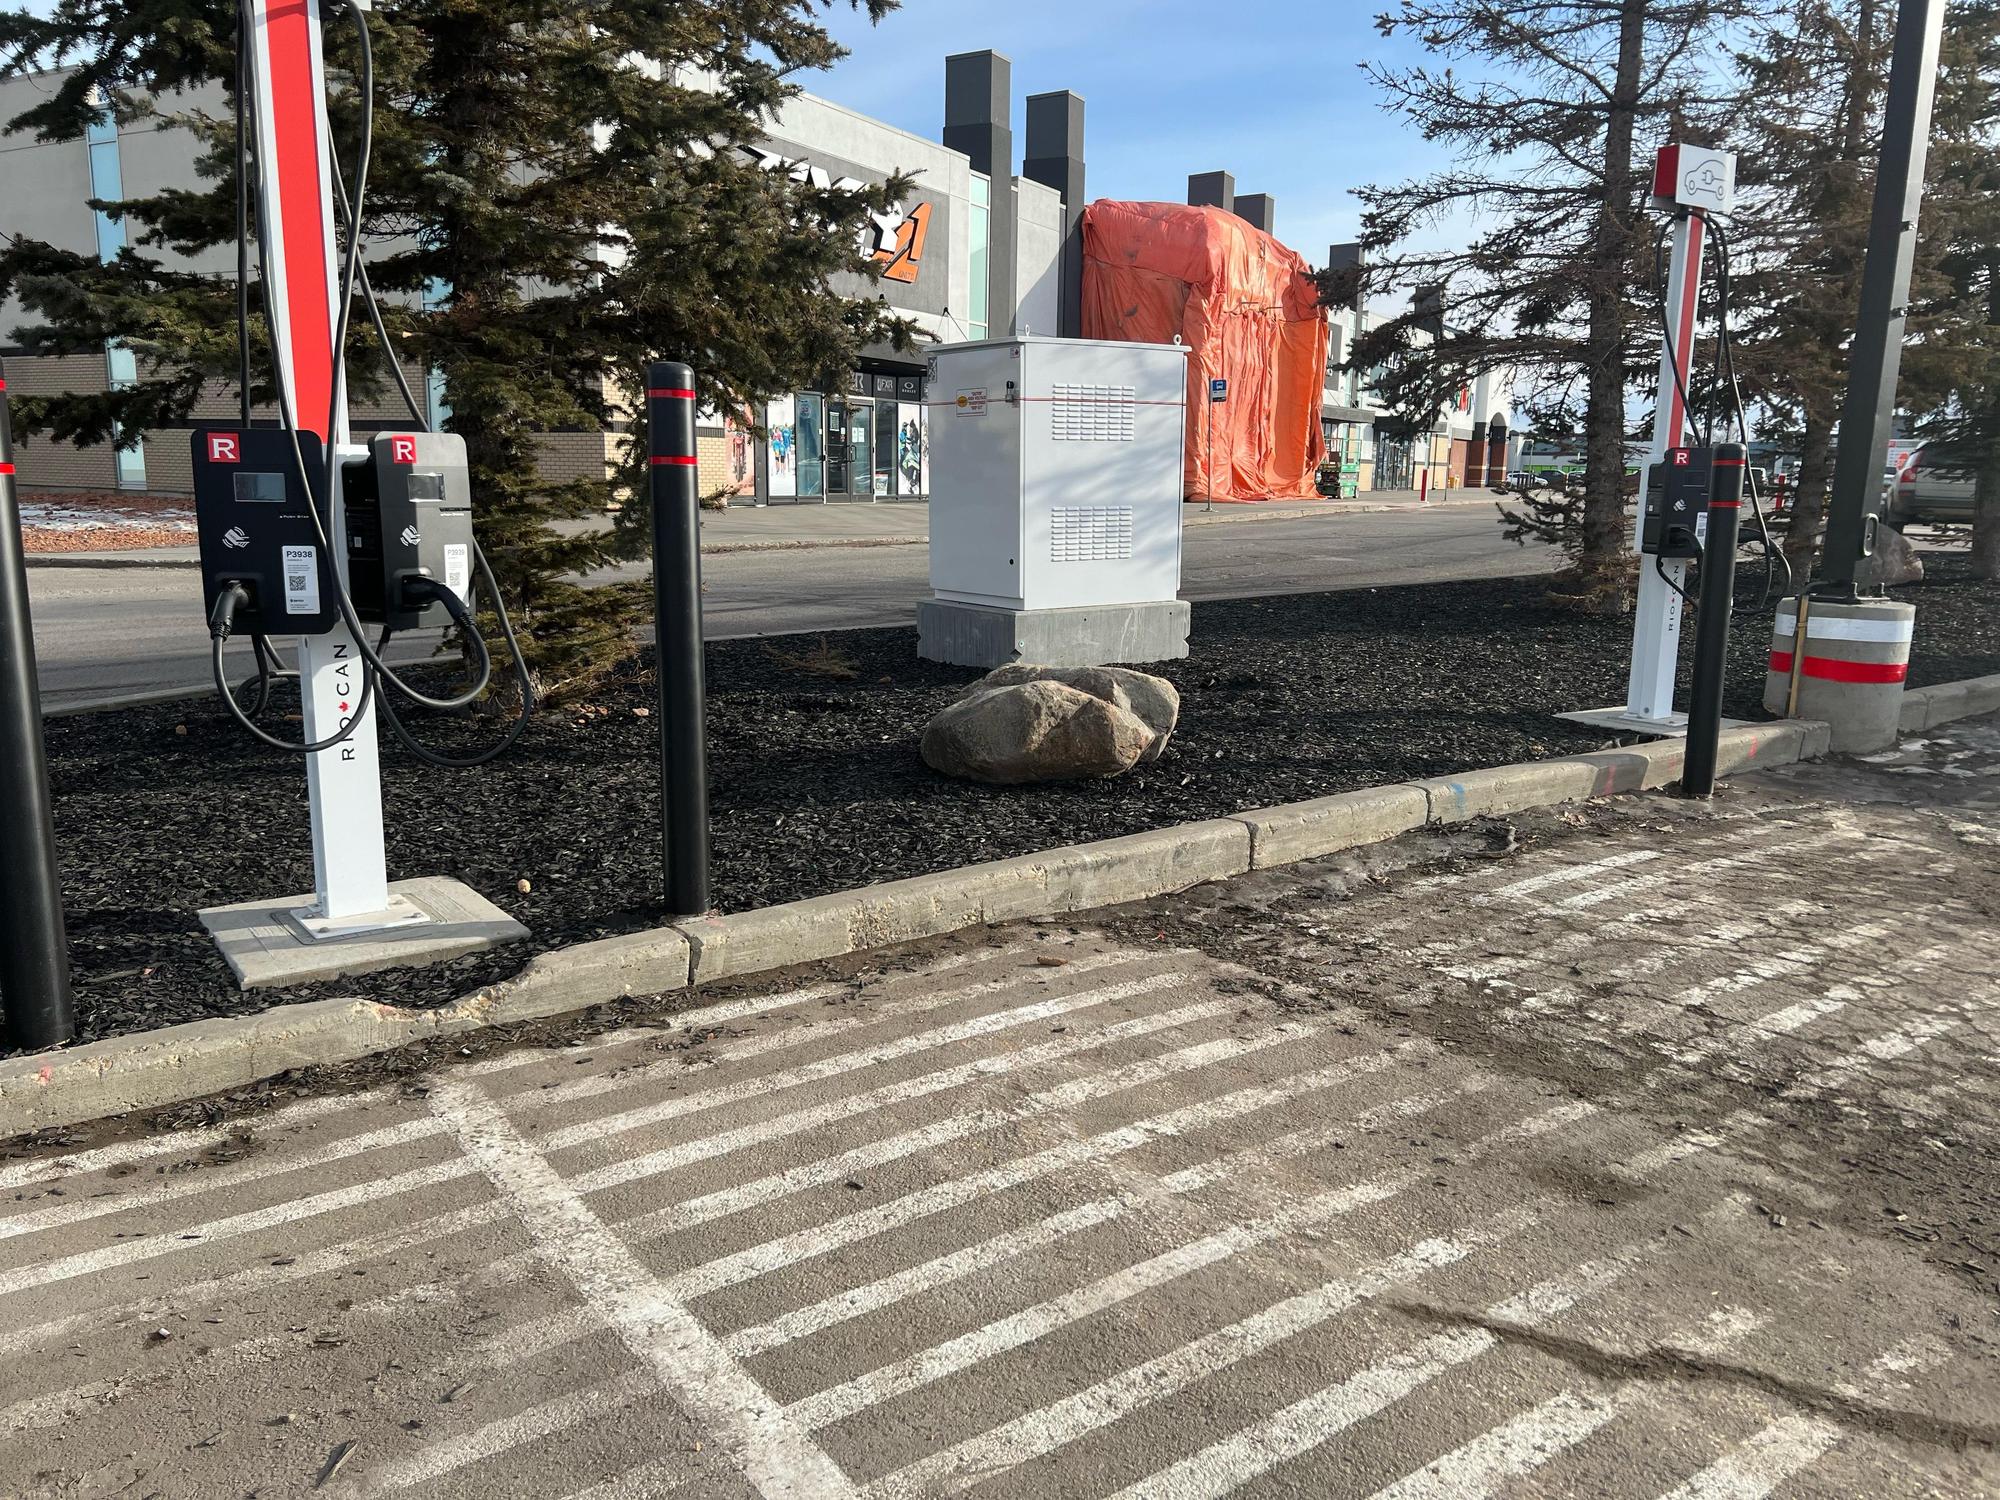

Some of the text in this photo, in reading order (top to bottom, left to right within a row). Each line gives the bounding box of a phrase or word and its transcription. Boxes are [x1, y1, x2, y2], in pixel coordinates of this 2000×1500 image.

[212, 438, 237, 459] R
[396, 441, 413, 461] R
[1676, 452, 1688, 464] R
[286, 550, 313, 558] P3938
